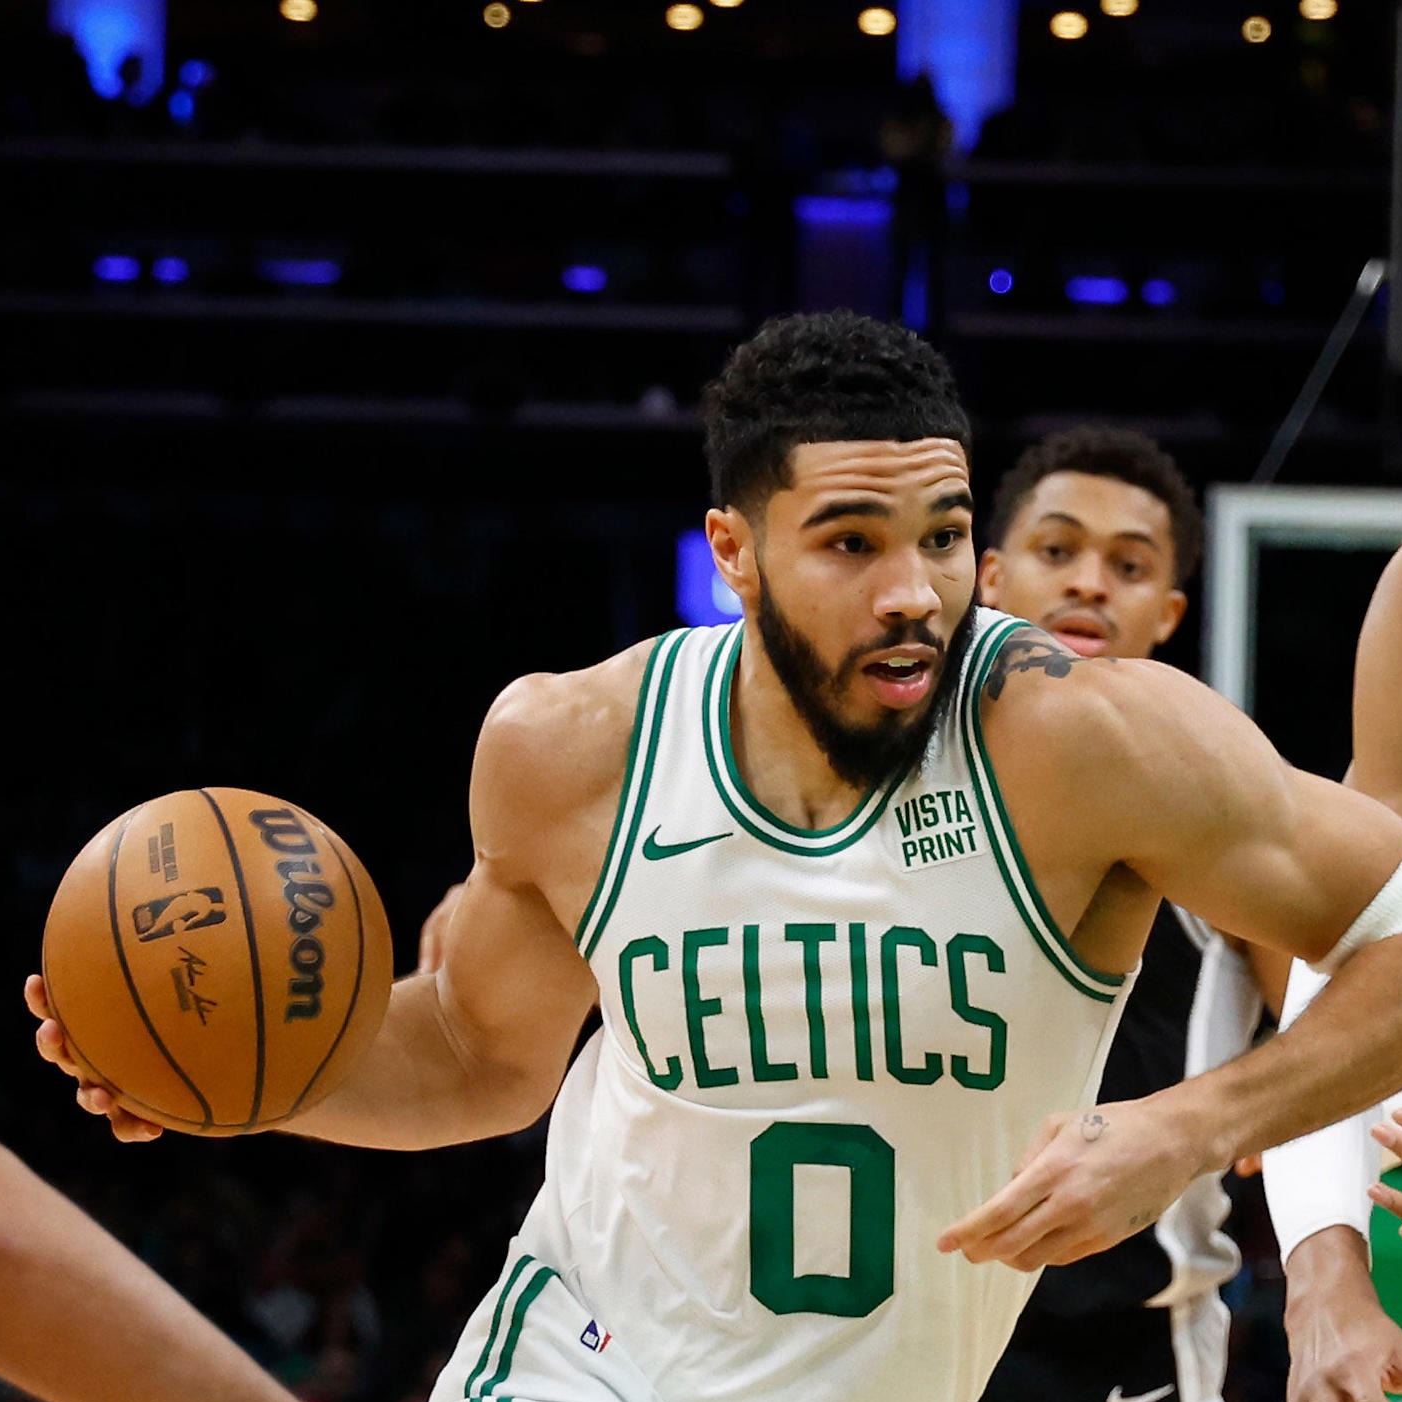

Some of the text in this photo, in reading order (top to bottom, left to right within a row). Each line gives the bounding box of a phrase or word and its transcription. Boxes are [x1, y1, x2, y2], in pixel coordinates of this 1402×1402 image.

[895, 790, 974, 838] VISTA
[902, 826, 978, 867] PRINT
[249, 807, 336, 1024] Wilson
[618, 922, 1008, 1092] CELTICS
[749, 1121, 895, 1318] 0
